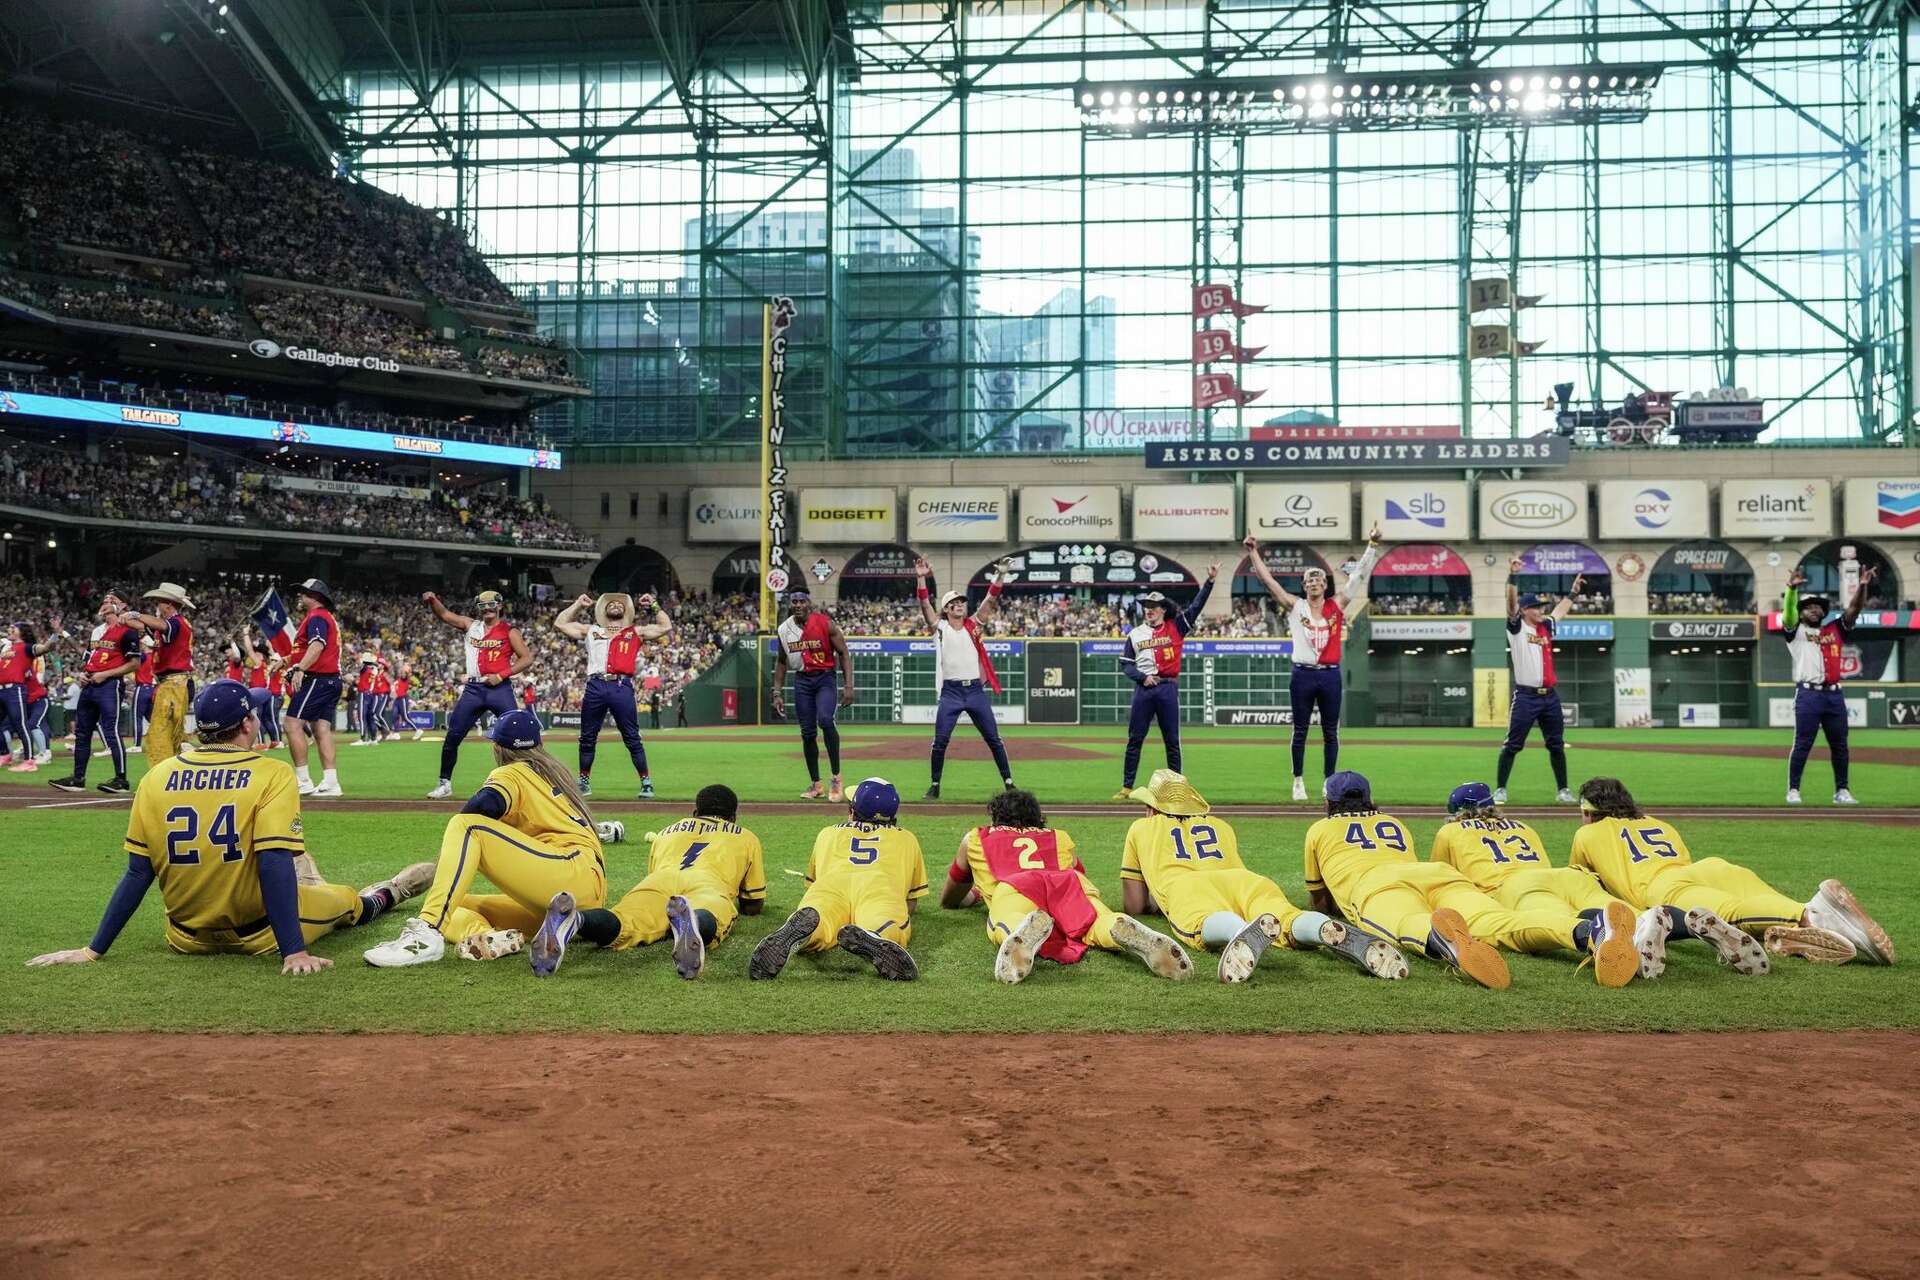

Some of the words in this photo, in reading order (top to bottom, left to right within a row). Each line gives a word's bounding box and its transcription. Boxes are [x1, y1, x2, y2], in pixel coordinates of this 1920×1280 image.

[1200, 289, 1225, 309] 05
[1477, 284, 1500, 303] 17
[1202, 336, 1225, 354] 19
[1477, 332, 1499, 350] 22
[284, 345, 361, 368] Gallagher
[362, 356, 400, 373] Club
[770, 336, 788, 445] CHIKIN
[1200, 379, 1223, 398] 21
[121, 406, 181, 427] TAILGATERS
[1274, 428, 1354, 437] DAIKIN
[1372, 427, 1425, 436] PARK
[393, 436, 444, 454] TAILGATERS
[1162, 447, 1255, 462] ASTROS
[1267, 445, 1426, 461] COMMUNITY
[1437, 443, 1551, 459] LEADERS
[917, 501, 1000, 513] CHENIERE
[1408, 492, 1446, 514] slb
[1501, 499, 1564, 520] COTTON
[1634, 503, 1670, 513] OXY
[1737, 494, 1808, 513] reliant
[716, 508, 763, 520] CALPIN
[808, 509, 887, 520] DOGGETT
[1026, 514, 1114, 528] ConocoPhillips
[1138, 508, 1230, 517] HALLIBURTON
[769, 490, 786, 567] FAIR
[1258, 516, 1339, 528] LEXUS
[1534, 550, 1577, 563] planet
[1674, 550, 1706, 565] SPACE
[1706, 550, 1729, 564] CITY
[1391, 562, 1430, 572] equinor
[1539, 560, 1585, 572] fitness
[1684, 623, 1739, 638] EMCJET
[739, 640, 758, 650] 315
[786, 639, 822, 653] TAILGATERS
[908, 641, 937, 650] GEIC
[1135, 636, 1172, 651] TAILGATERS
[893, 657, 902, 721] NATIONAL
[1030, 687, 1076, 698] BETMGM
[1204, 658, 1214, 722] AMERICAN
[1442, 686, 1468, 697] 366
[165, 769, 252, 792] ARCHER
[166, 803, 244, 865] 24
[722, 821, 742, 834] KID
[1344, 820, 1408, 853] 49
[848, 836, 880, 866] 5
[1169, 823, 1225, 861] 12
[1620, 827, 1678, 863] 15
[1012, 837, 1046, 870] 2
